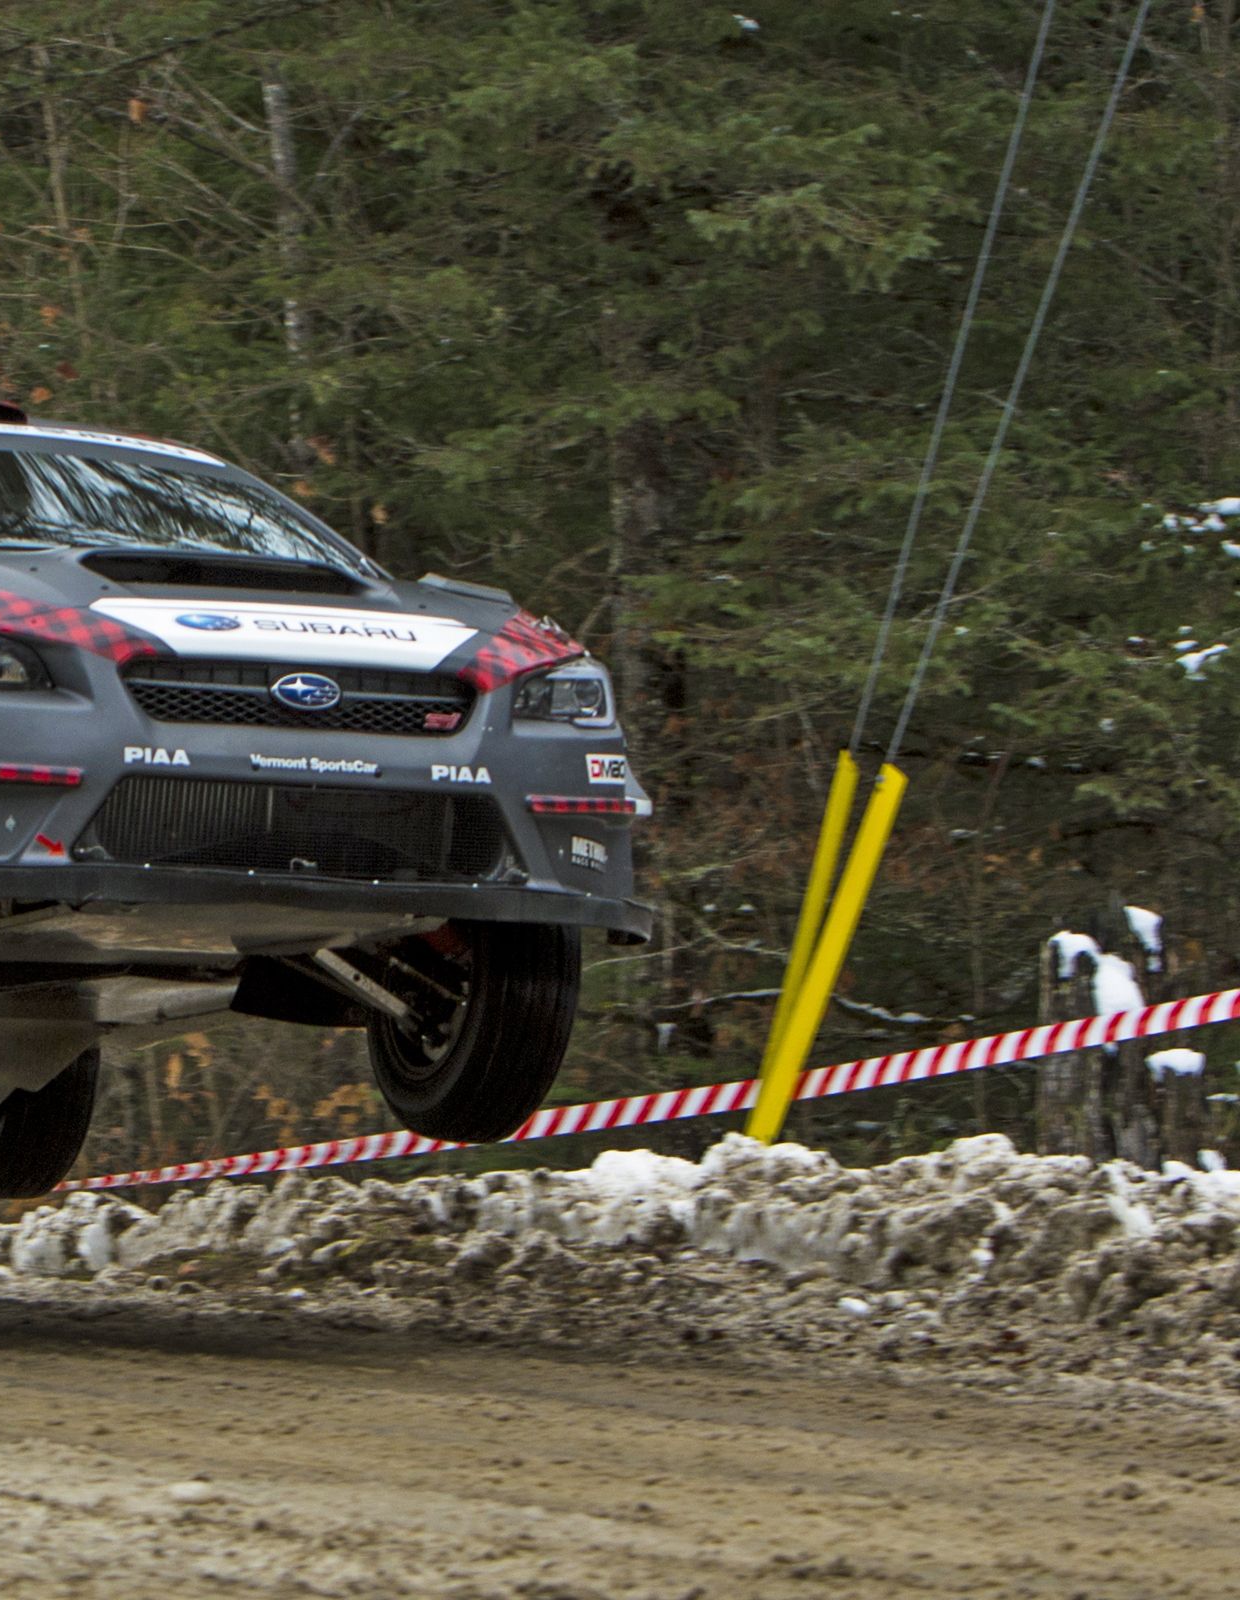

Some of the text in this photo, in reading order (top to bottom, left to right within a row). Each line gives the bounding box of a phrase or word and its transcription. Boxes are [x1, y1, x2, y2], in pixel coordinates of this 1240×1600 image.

[253, 619, 417, 642] SUBARU
[124, 747, 190, 766] PIAA
[250, 753, 378, 773] Vermont SportsCar
[431, 765, 492, 784] PIAA
